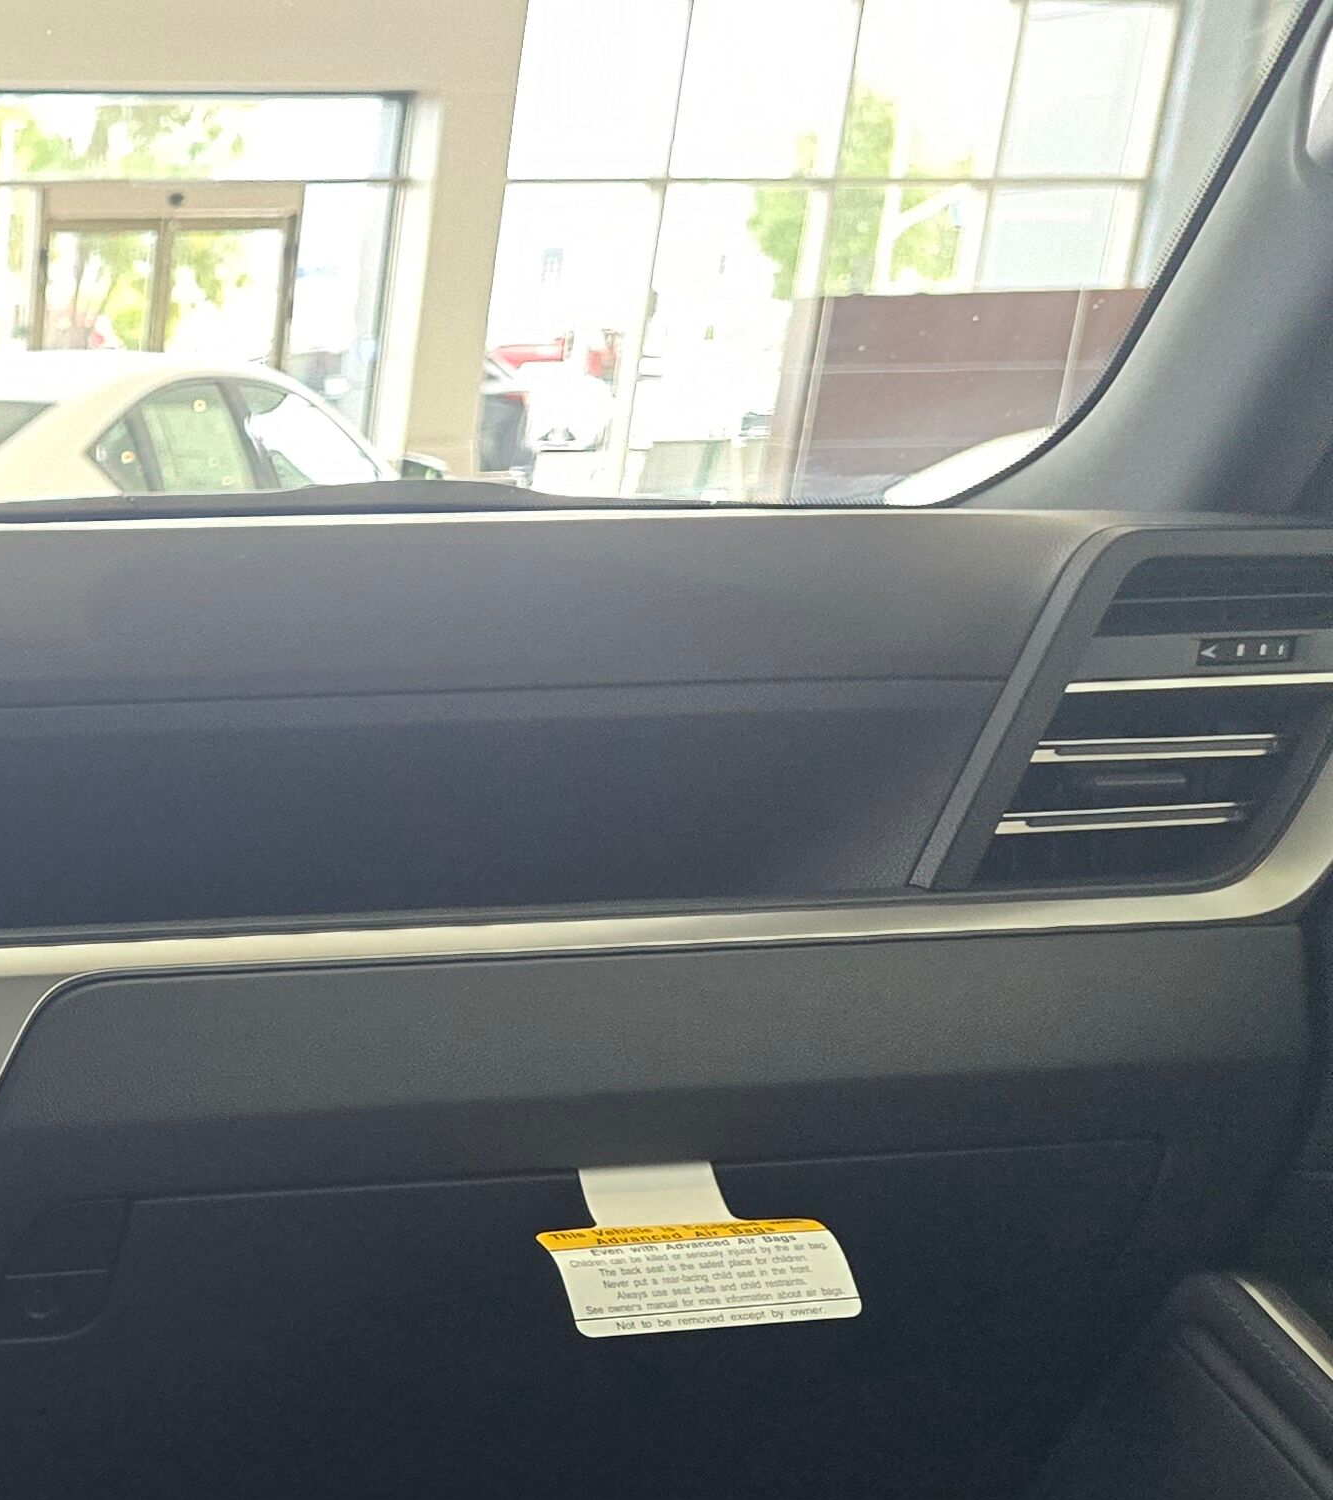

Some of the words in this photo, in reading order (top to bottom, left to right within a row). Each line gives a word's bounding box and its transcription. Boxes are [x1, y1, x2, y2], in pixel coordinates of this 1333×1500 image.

[549, 1231, 586, 1240] This
[590, 1247, 624, 1256] Even
[630, 1244, 658, 1253] with
[666, 1239, 730, 1250] Advanced
[738, 1237, 755, 1245] Air
[761, 1235, 797, 1243] Bags
[597, 1231, 683, 1245] Advanced
[695, 1230, 718, 1238] Air
[729, 1226, 775, 1235] Bags
[569, 1259, 607, 1268] Children
[610, 1257, 627, 1265] can
[645, 1252, 669, 1261] killed
[759, 1245, 771, 1255] by
[598, 1268, 617, 1277] The
[620, 1266, 642, 1275] back
[646, 1265, 665, 1273] seat
[680, 1262, 695, 1270] the
[728, 1259, 752, 1268] place
[755, 1256, 767, 1265] for
[602, 1279, 629, 1289] Never
[633, 1278, 648, 1288] put
[712, 1271, 733, 1280] child
[736, 1269, 756, 1279] seat
[759, 1268, 769, 1277] in
[771, 1267, 786, 1276] the
[617, 1290, 648, 1301] Always
[651, 1289, 668, 1297] use
[672, 1287, 691, 1296] seat
[720, 1283, 737, 1292] and
[740, 1280, 761, 1290] child
[585, 1305, 604, 1315] See
[646, 1299, 679, 1310] manual
[682, 1298, 694, 1307] for
[698, 1297, 722, 1306] more
[777, 1289, 803, 1299] about
[615, 1320, 636, 1330] Not
[640, 1320, 652, 1329] to
[657, 1318, 672, 1327] be
[677, 1313, 724, 1325] removed
[730, 1310, 766, 1322] except
[770, 1308, 784, 1319] by
[790, 1307, 827, 1316] owner.
